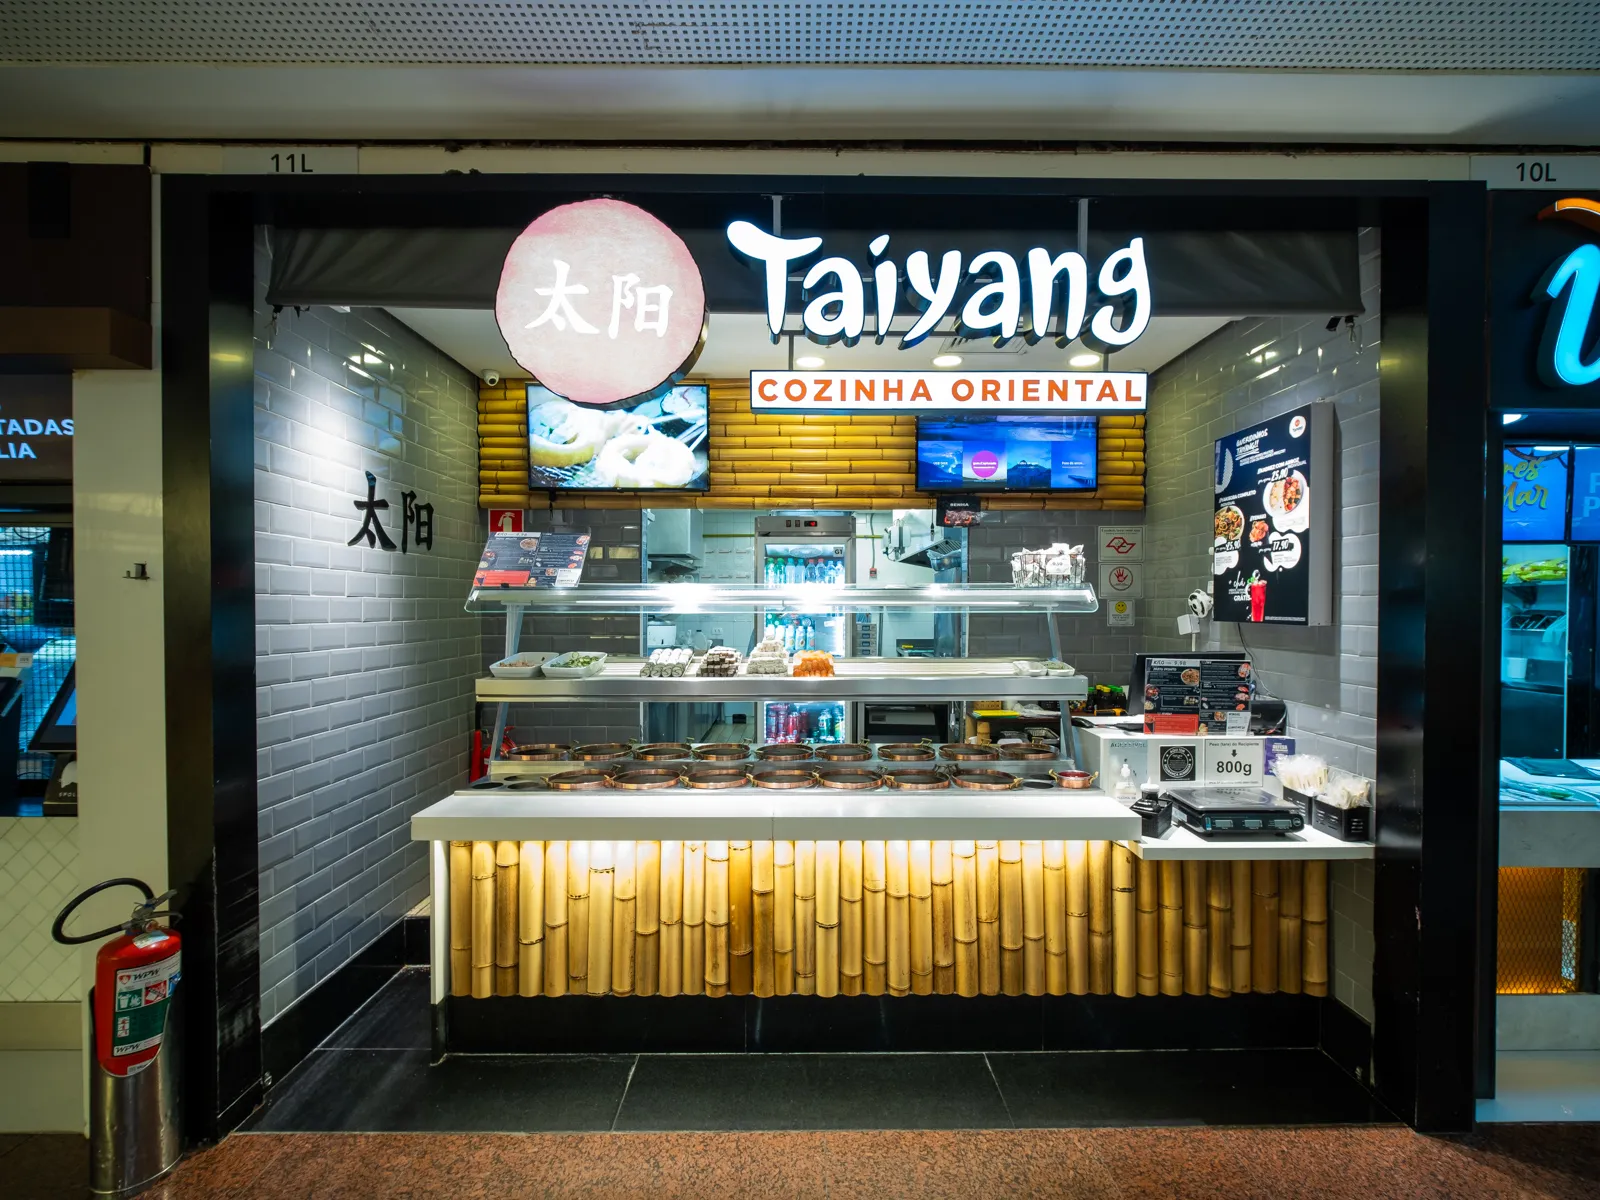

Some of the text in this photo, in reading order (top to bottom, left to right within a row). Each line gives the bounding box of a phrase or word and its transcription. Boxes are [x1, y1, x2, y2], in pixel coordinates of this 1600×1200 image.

[270, 153, 313, 173] 11L
[1516, 162, 1557, 182] 10L
[726, 220, 1151, 347] Taiyang
[523, 258, 673, 341] 太阳
[757, 378, 1142, 402] COZINHA ORIENTAL
[347, 470, 435, 555] 太阳
[1216, 761, 1252, 776] 800g
